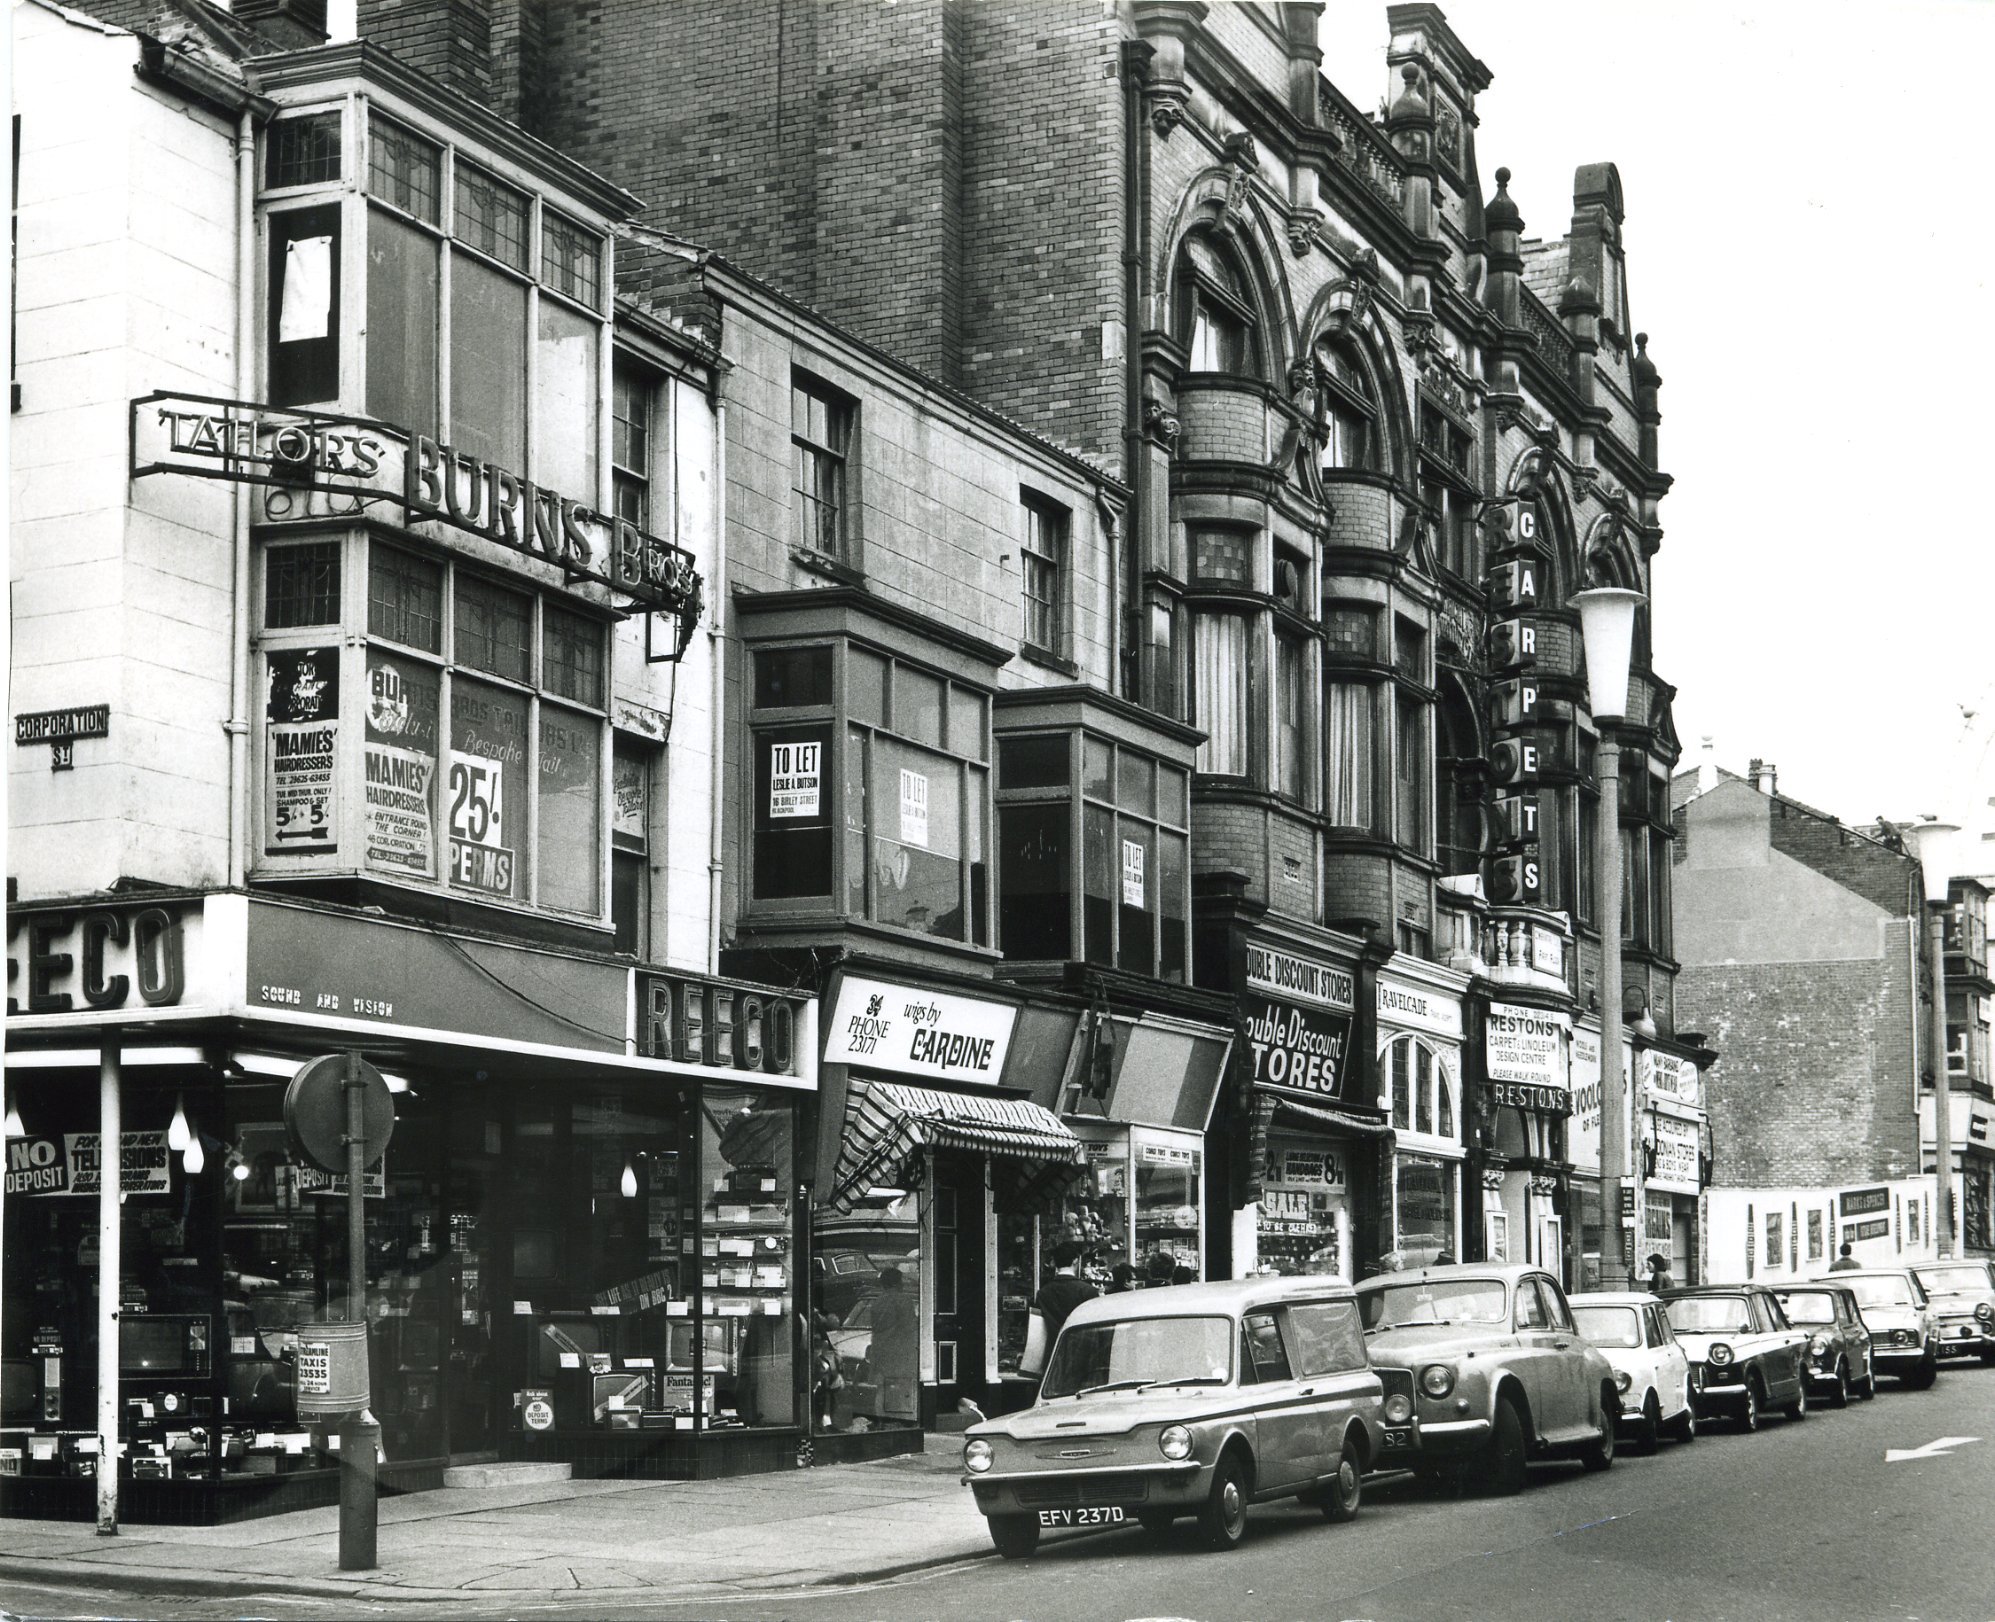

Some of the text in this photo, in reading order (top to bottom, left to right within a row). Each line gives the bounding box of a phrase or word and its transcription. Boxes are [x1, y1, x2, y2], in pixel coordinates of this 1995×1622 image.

[158, 408, 386, 478] TAILORS
[409, 434, 593, 570] BURNS
[1520, 511, 1539, 888] CARPETS
[17, 710, 104, 739] CORPORATION
[53, 746, 69, 765] ST
[774, 746, 817, 774] TO LET
[773, 778, 790, 790] LESLIE
[903, 773, 925, 805] TO LET
[276, 796, 309, 806] SHAMPOO
[316, 796, 329, 804] SET
[366, 786, 426, 815] HAIRDRESSERS
[800, 795, 818, 804] STREET
[374, 812, 428, 831] ENTRANCE ROUND
[375, 822, 389, 832] THE
[450, 842, 510, 890] PERMS
[1275, 954, 1319, 995] DISCOUNT
[1321, 969, 1352, 1004] STORES
[261, 985, 393, 1017] SOUND AND VISION
[1503, 1006, 1528, 1018] PHONE
[644, 977, 795, 1075] REECO
[847, 1015, 891, 1039] PHONE
[904, 1001, 942, 1028] wigs by
[1490, 1016, 1553, 1036] RESTONS
[848, 1034, 878, 1055] 23171
[1286, 1008, 1342, 1059] Discount
[1521, 1039, 1556, 1052] LINOLEUM
[909, 1028, 995, 1071] CARDINE
[1496, 1050, 1546, 1065] DESIGN CENTRE
[1250, 1041, 1336, 1092] TORES
[1493, 1068, 1551, 1083] PLEASE WALK ROUND
[1495, 1084, 1564, 1110] RESTONS
[11, 1140, 56, 1171] NO
[75, 1136, 99, 1149] FOR
[1088, 1143, 1109, 1152] TOYS
[6, 1166, 64, 1194] DEPOSIT
[1265, 1191, 1308, 1220] SALE
[607, 1286, 622, 1305] LIFE
[639, 1284, 674, 1310] ON BBC 2
[300, 1357, 327, 1367] TAXIS
[1038, 1506, 1124, 1526] EFV 237D
